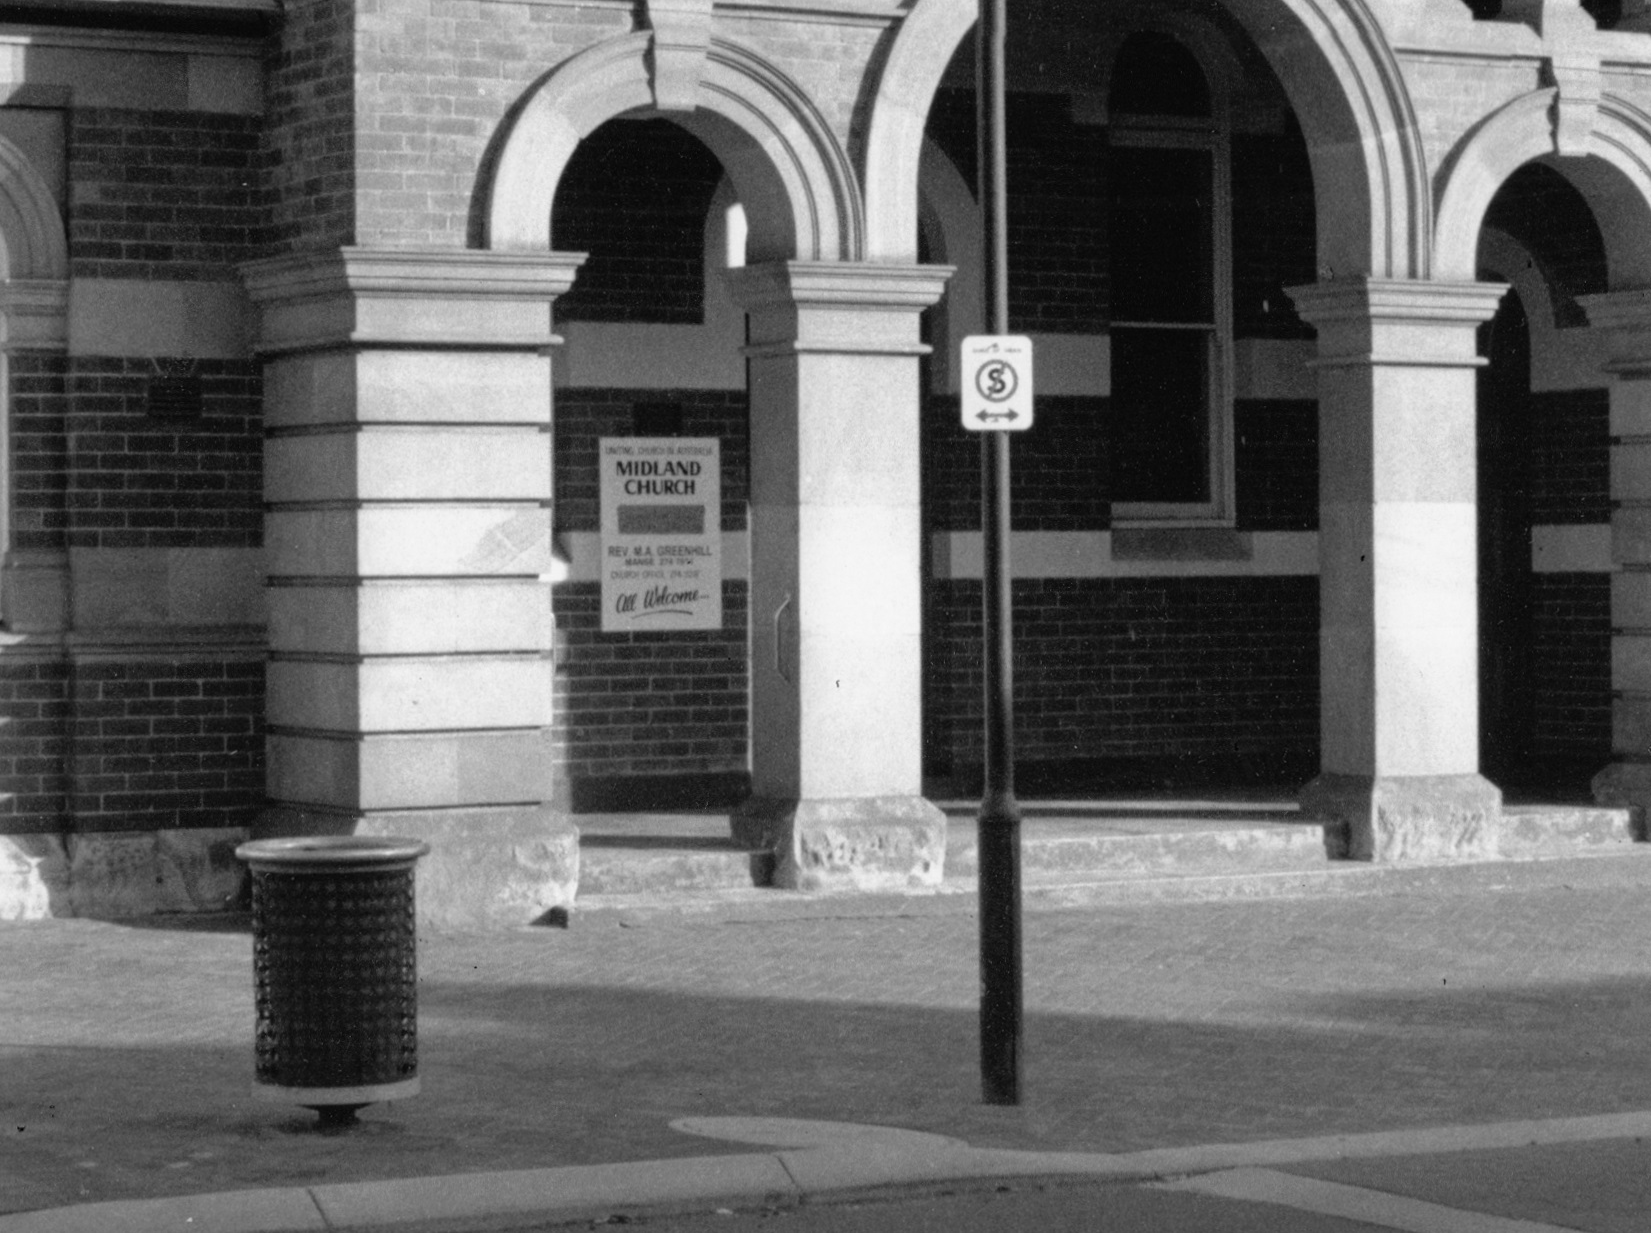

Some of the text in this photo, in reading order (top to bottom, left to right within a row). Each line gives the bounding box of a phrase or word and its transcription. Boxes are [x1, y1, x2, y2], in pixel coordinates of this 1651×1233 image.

[616, 461, 702, 477] MIDLAND
[624, 479, 696, 495] CHURCH
[657, 545, 713, 557] GREENHILL
[616, 594, 638, 613] All
